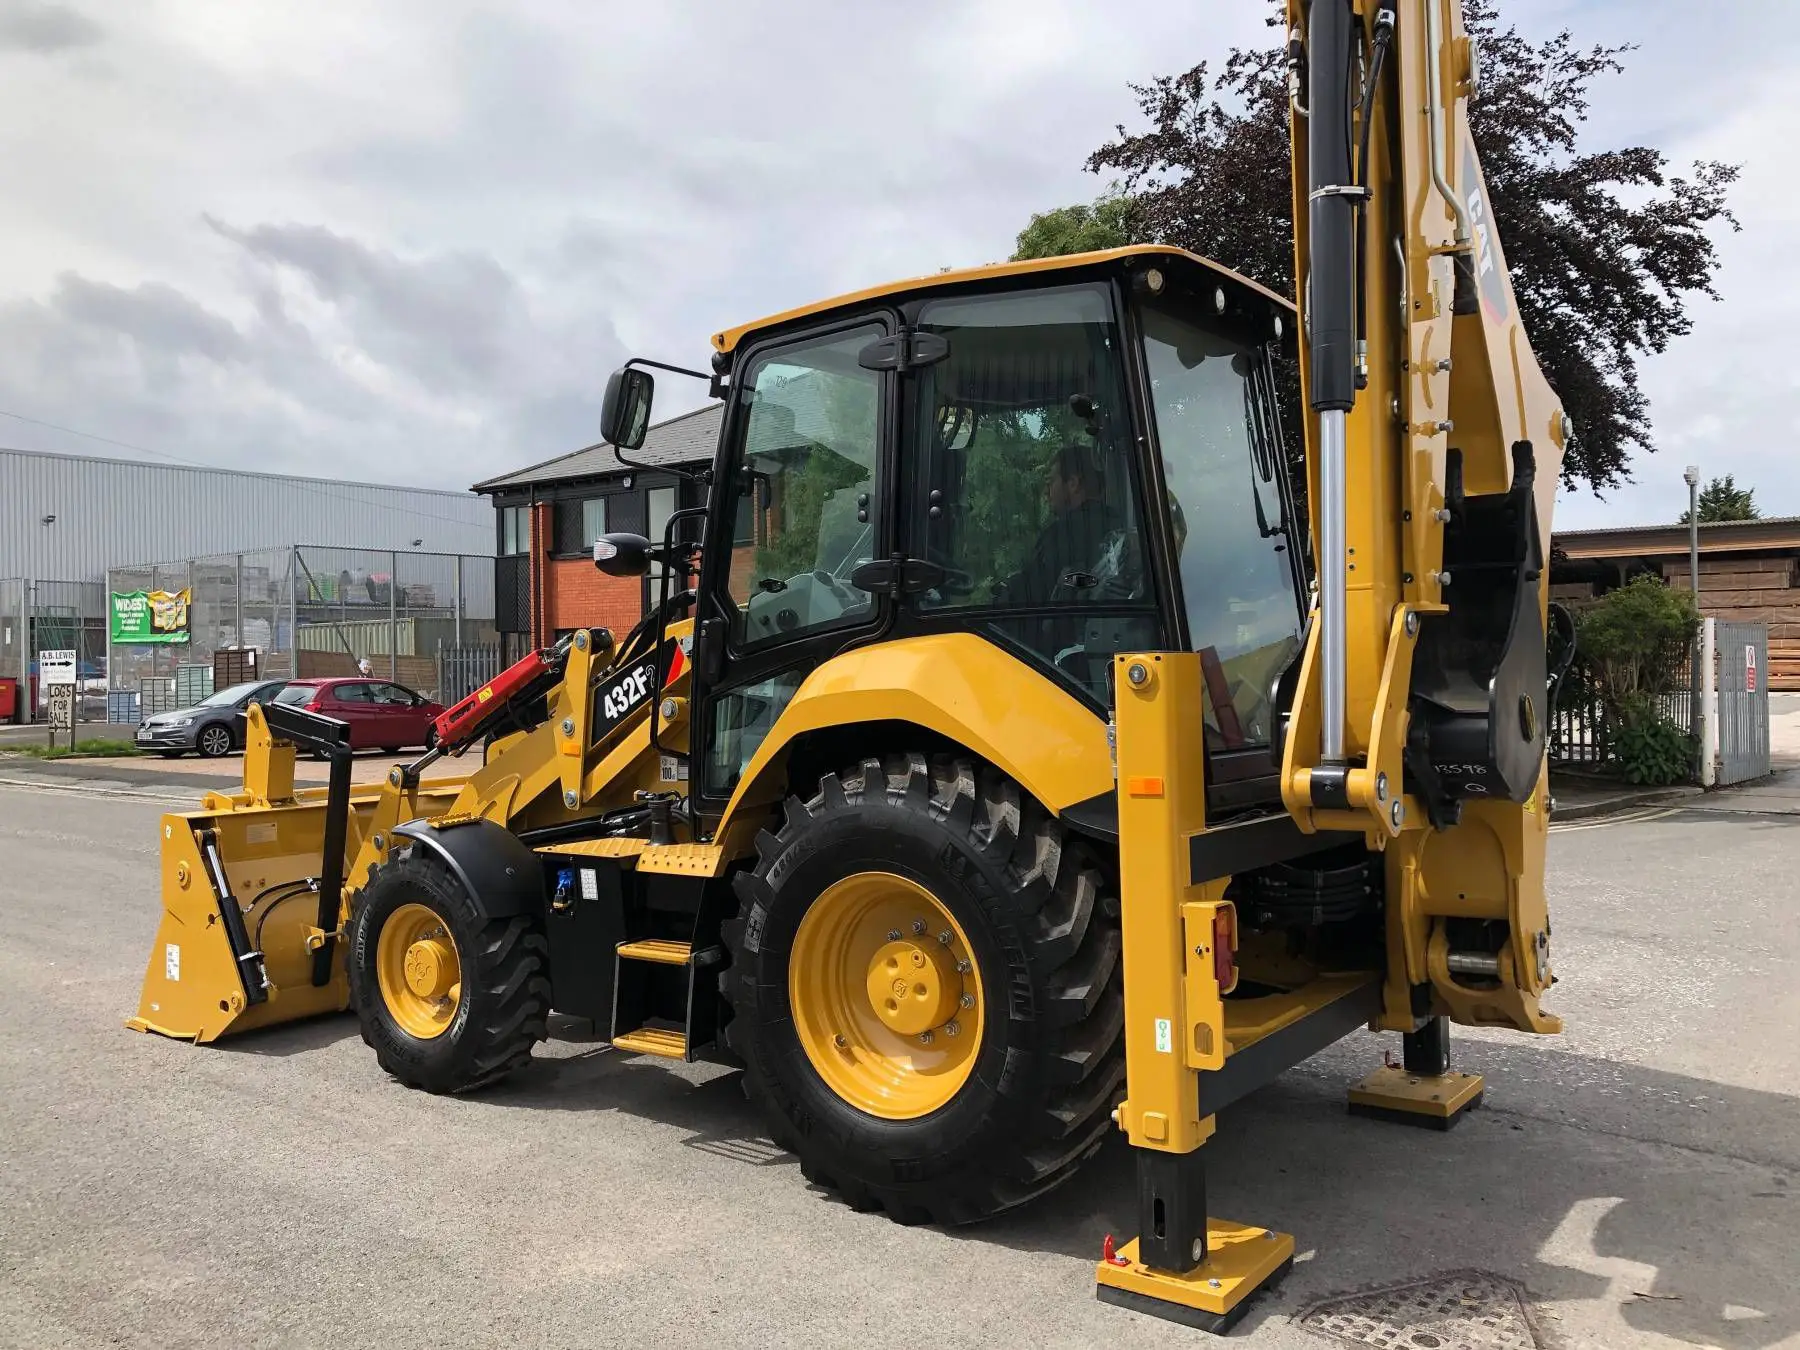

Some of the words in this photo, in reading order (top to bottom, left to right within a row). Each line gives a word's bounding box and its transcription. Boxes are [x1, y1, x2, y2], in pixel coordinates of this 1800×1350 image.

[115, 597, 147, 611] WIDEST
[56, 651, 75, 660] LEWIS
[50, 685, 71, 698] LOGS
[54, 700, 68, 711] FOR
[49, 711, 68, 723] SALE
[1434, 764, 1488, 775] 13598
